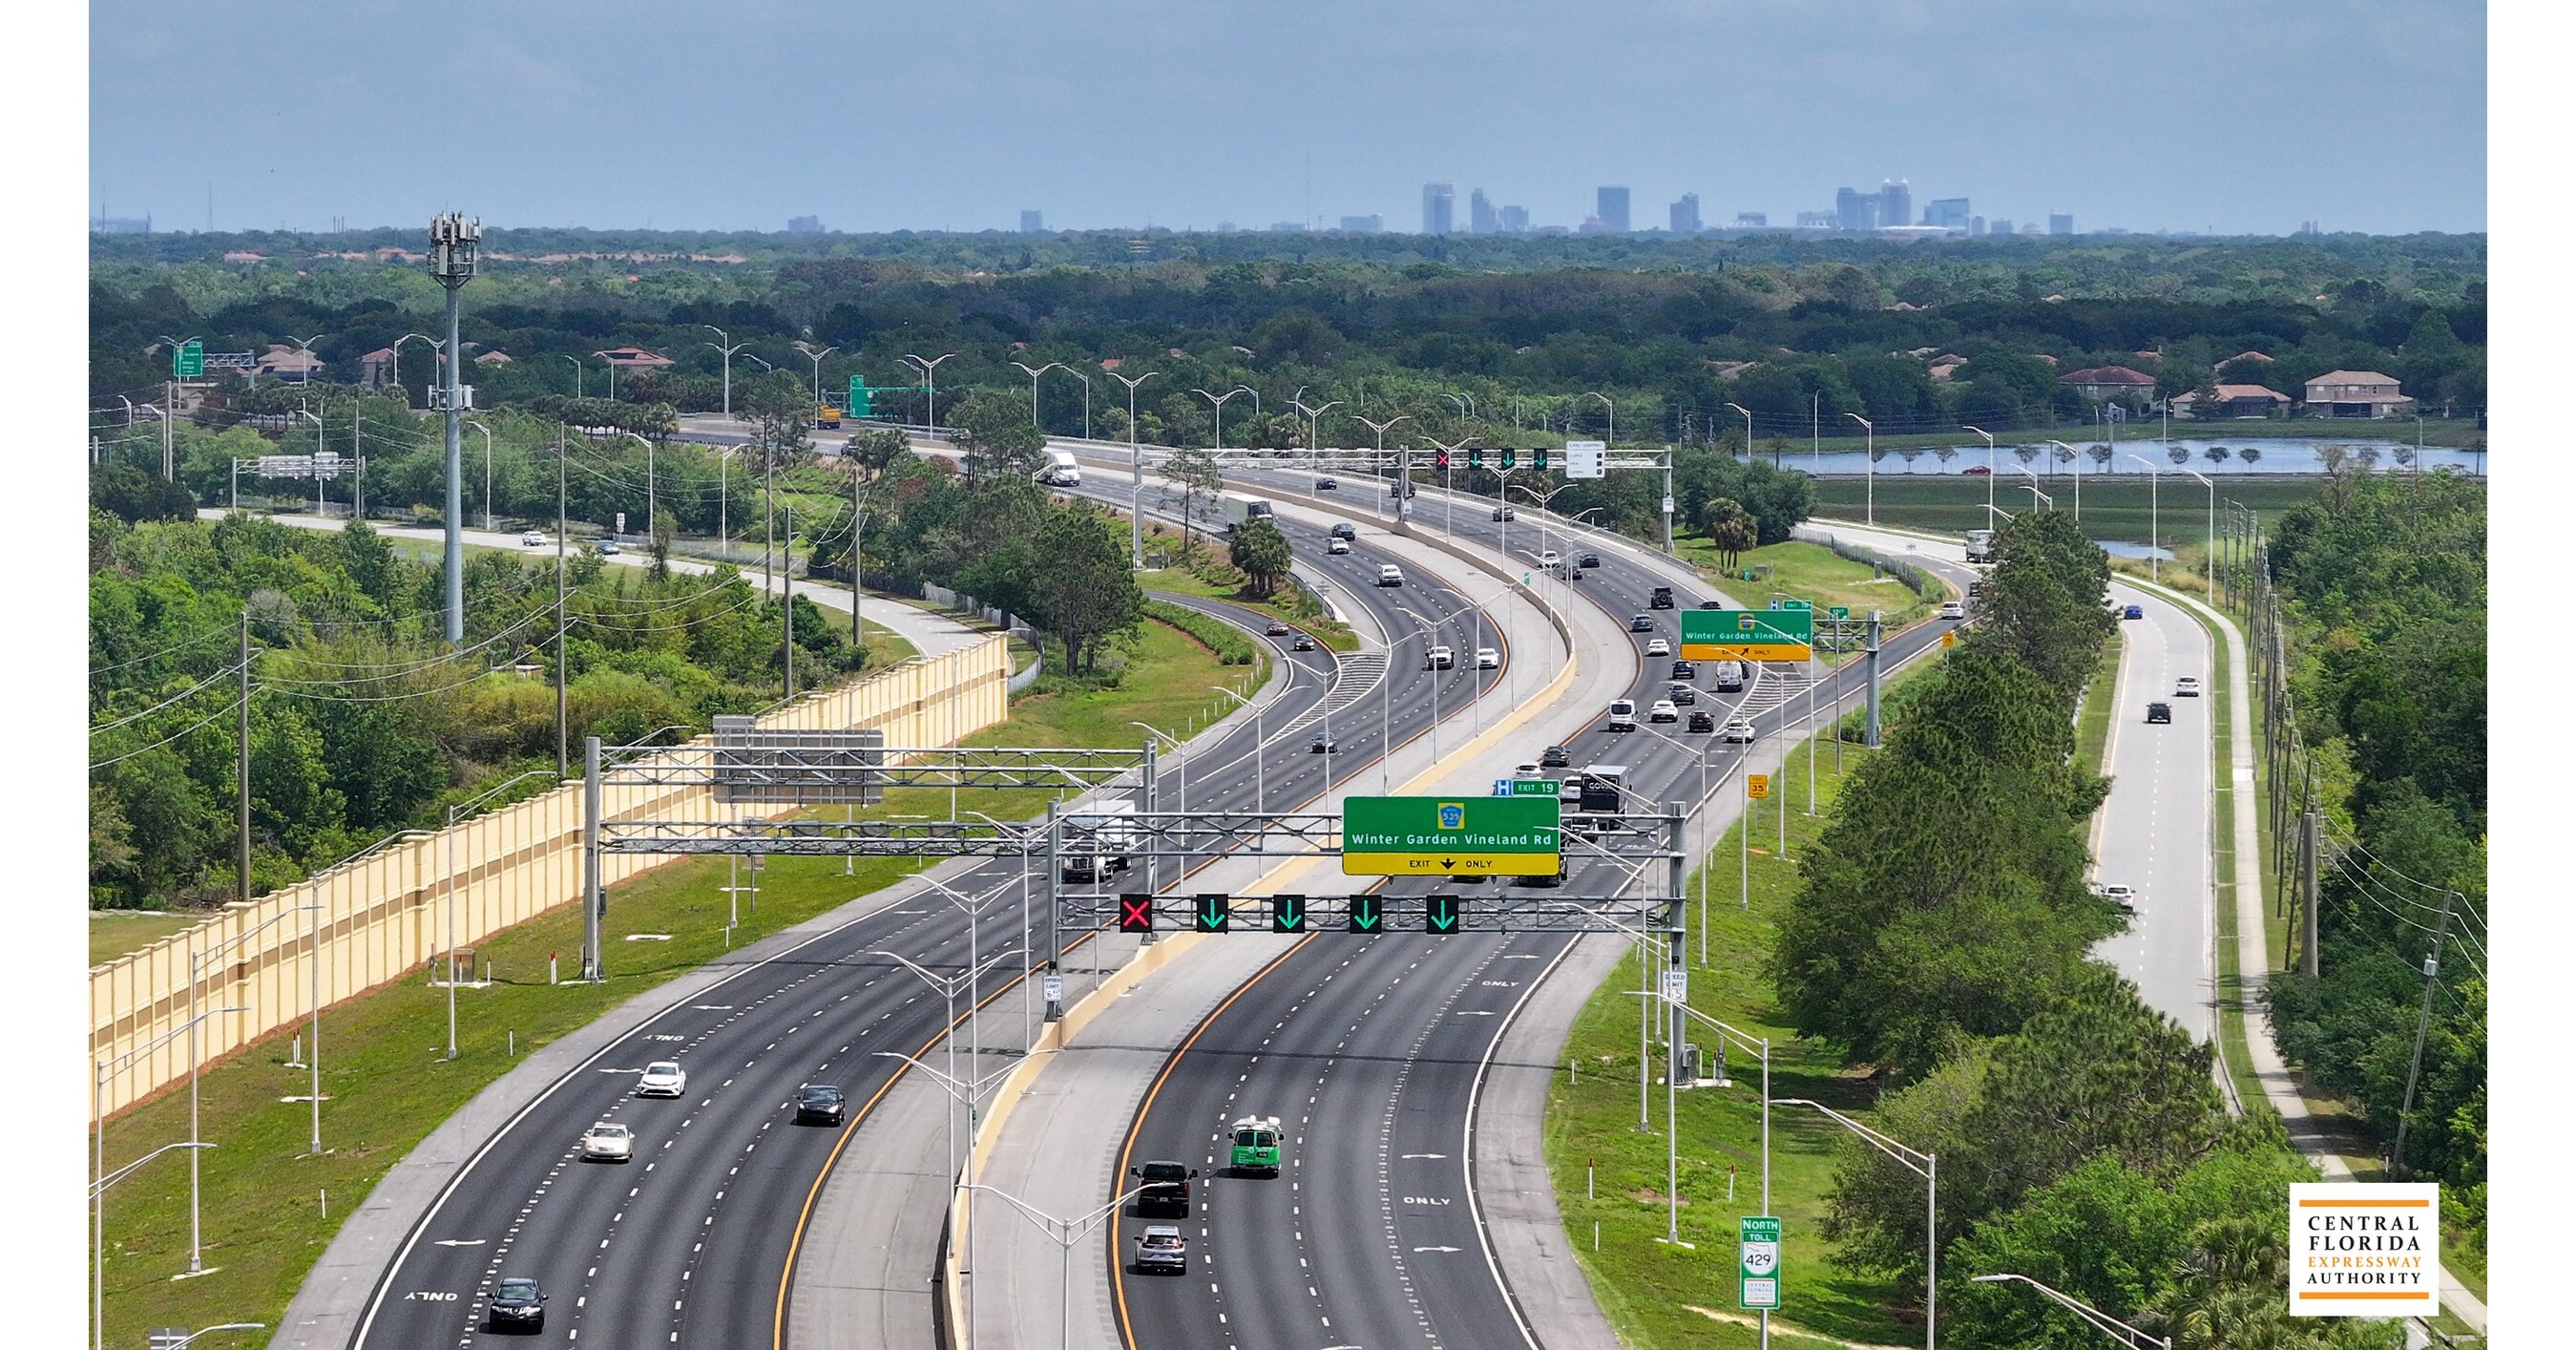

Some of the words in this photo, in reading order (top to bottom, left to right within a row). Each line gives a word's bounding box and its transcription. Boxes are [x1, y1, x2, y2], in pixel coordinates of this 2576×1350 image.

[1541, 783, 1554, 792] 19
[1443, 812, 1459, 821] 535
[1351, 833, 1399, 844] Winter
[1407, 833, 1457, 844] Garden
[1464, 833, 1527, 845] Vineland
[1534, 834, 1551, 845] Rd
[1403, 1196, 1451, 1205] ONLY
[1743, 1220, 1778, 1230] NORTH
[1746, 1254, 1771, 1266] 429
[404, 1292, 458, 1300] ONLY
